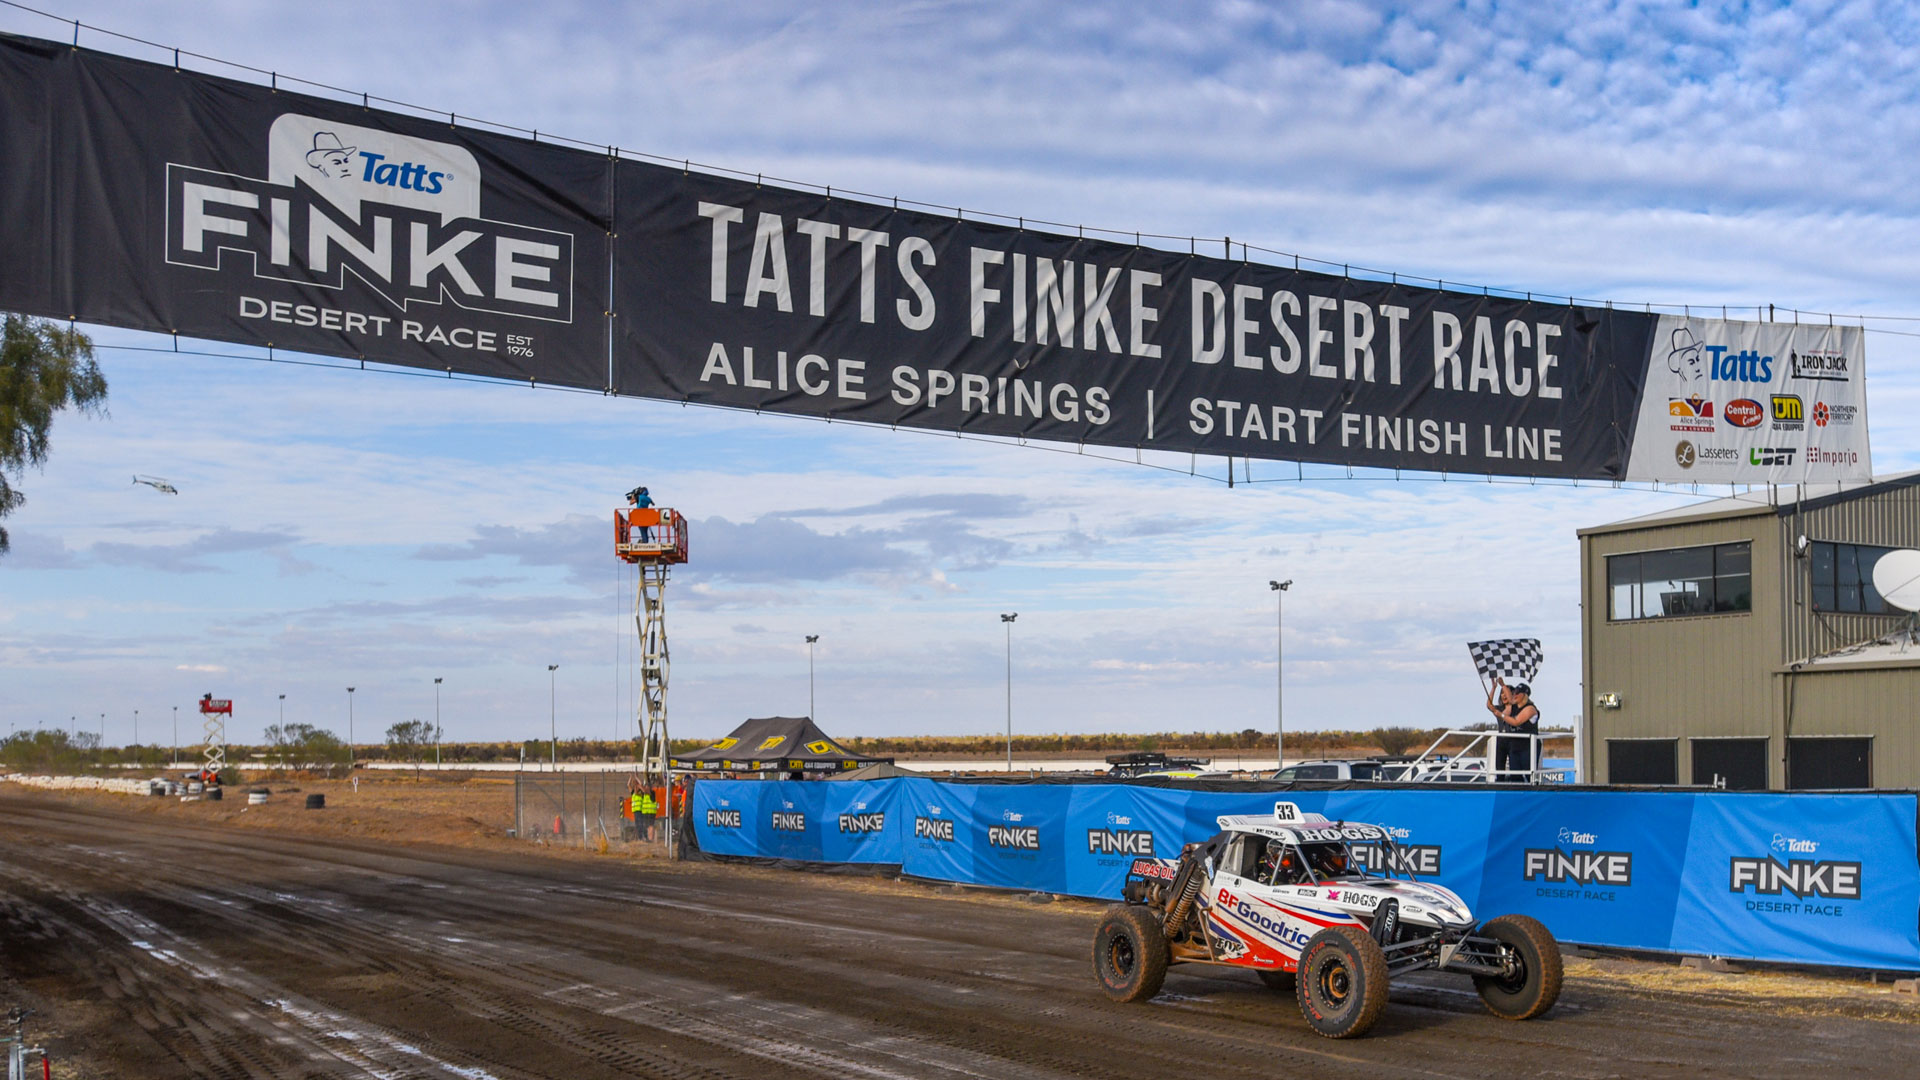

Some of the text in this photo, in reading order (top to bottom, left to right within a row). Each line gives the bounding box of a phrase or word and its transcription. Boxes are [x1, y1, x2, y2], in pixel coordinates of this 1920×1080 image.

[183, 182, 560, 307] FINKE
[698, 201, 1562, 399] TATTS FINKE DESERT RACE
[239, 296, 498, 352] DESERT RACE
[506, 334, 533, 347] EST
[506, 345, 534, 358] 1976
[1705, 345, 1773, 383] Tatts
[1801, 355, 1848, 372] IRON JACK
[699, 342, 1562, 462] ALICE SPRINGS START FINISH LINE
[1727, 404, 1756, 415] Central
[1829, 405, 1857, 414] NORTHERN
[1680, 417, 1714, 427] Alice Springs
[1829, 412, 1854, 421] TERRITORY
[1698, 443, 1739, 459] Lasseters
[1750, 448, 1796, 466] UBET
[707, 810, 741, 827] FINKE
[1276, 804, 1295, 820] 33
[772, 813, 805, 830] FINKE
[839, 814, 884, 832] FINKE
[915, 818, 953, 840] FINKE
[988, 828, 1039, 848] FINKE
[1088, 831, 1152, 854] FINKE
[1300, 827, 1382, 842] HOGS
[1571, 831, 1596, 845] Tatts
[1787, 838, 1817, 853] Tatts
[1351, 845, 1439, 872] FINKE
[1526, 852, 1629, 882] FINKE
[1132, 860, 1175, 880] LUCAS OIL
[1733, 861, 1857, 895] FINKE
[1342, 890, 1378, 907] HOGS
[1536, 887, 1616, 901] DESERT RACE
[1217, 887, 1311, 946] BFGoodric
[1746, 900, 1843, 917] DESERT RACE
